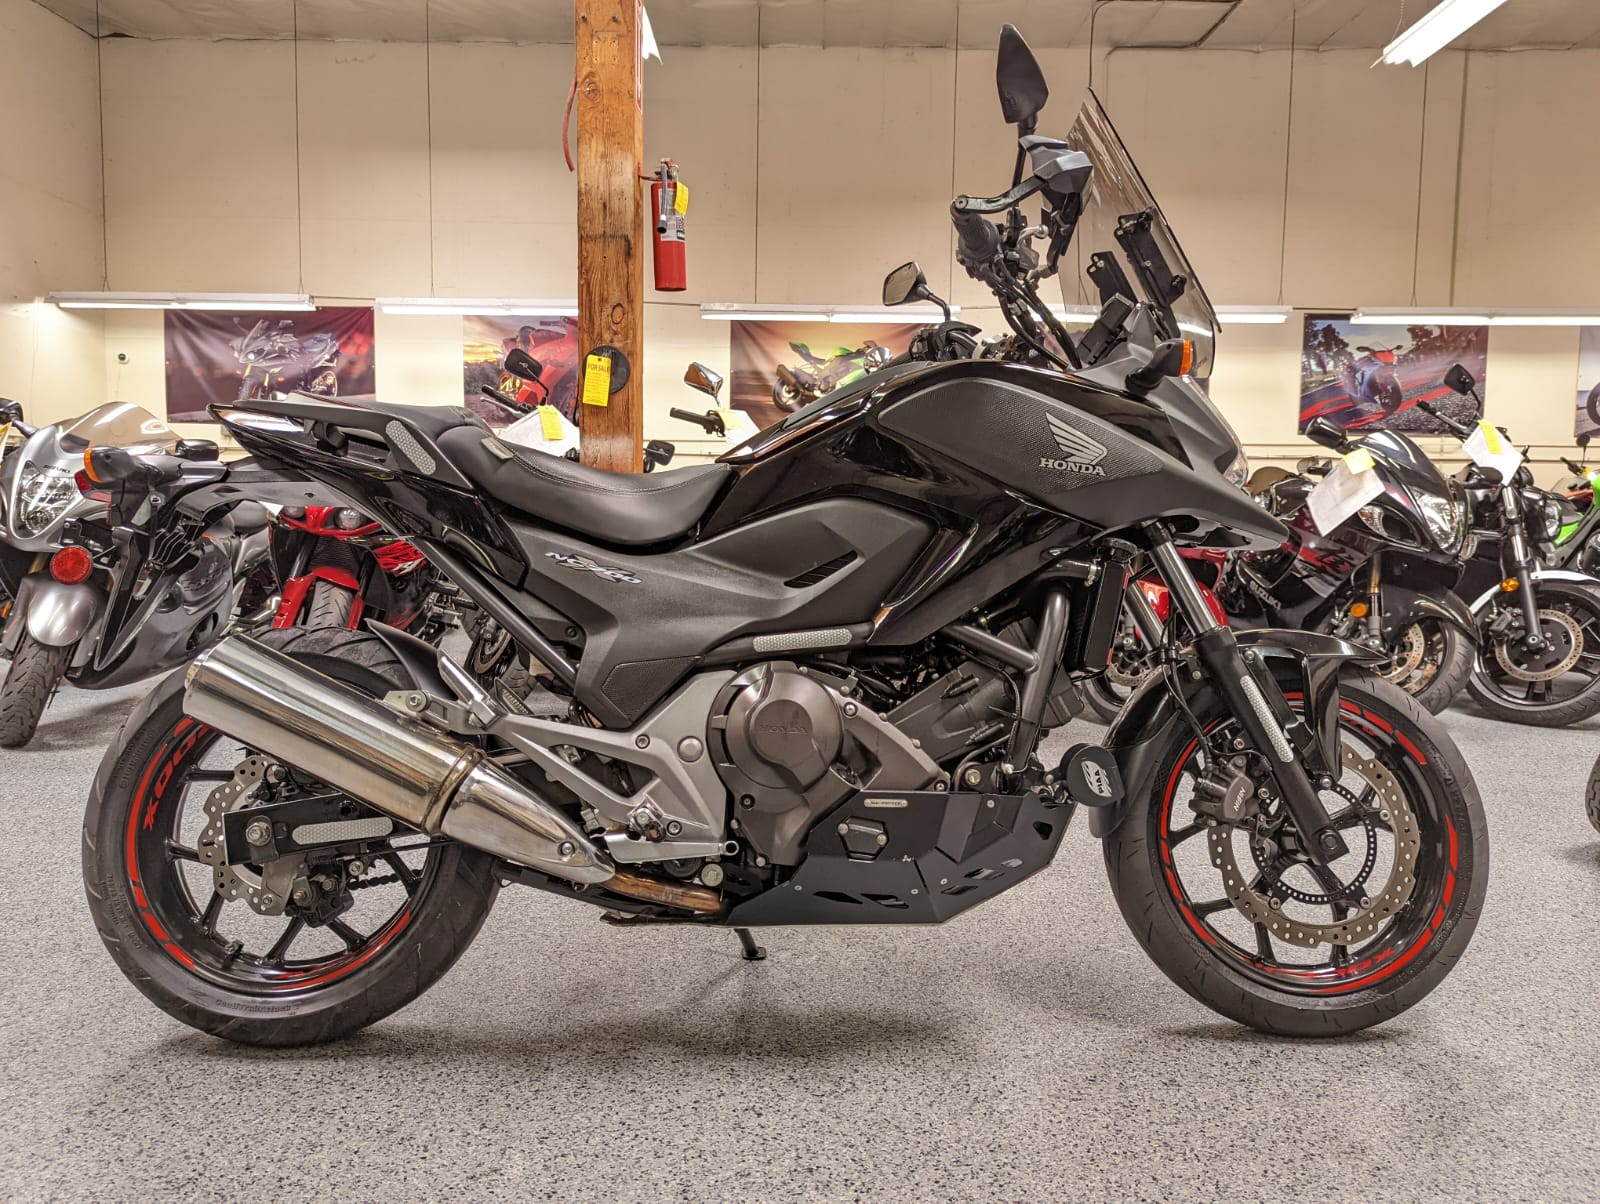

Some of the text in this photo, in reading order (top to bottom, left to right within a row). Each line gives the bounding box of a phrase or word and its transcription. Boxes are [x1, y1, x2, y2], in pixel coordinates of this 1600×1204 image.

[1039, 457, 1107, 477] HONDA
[1249, 580, 1281, 610] SUZUKI
[1094, 769, 1104, 794] PIAA
[1232, 786, 1246, 812] NISSIN
